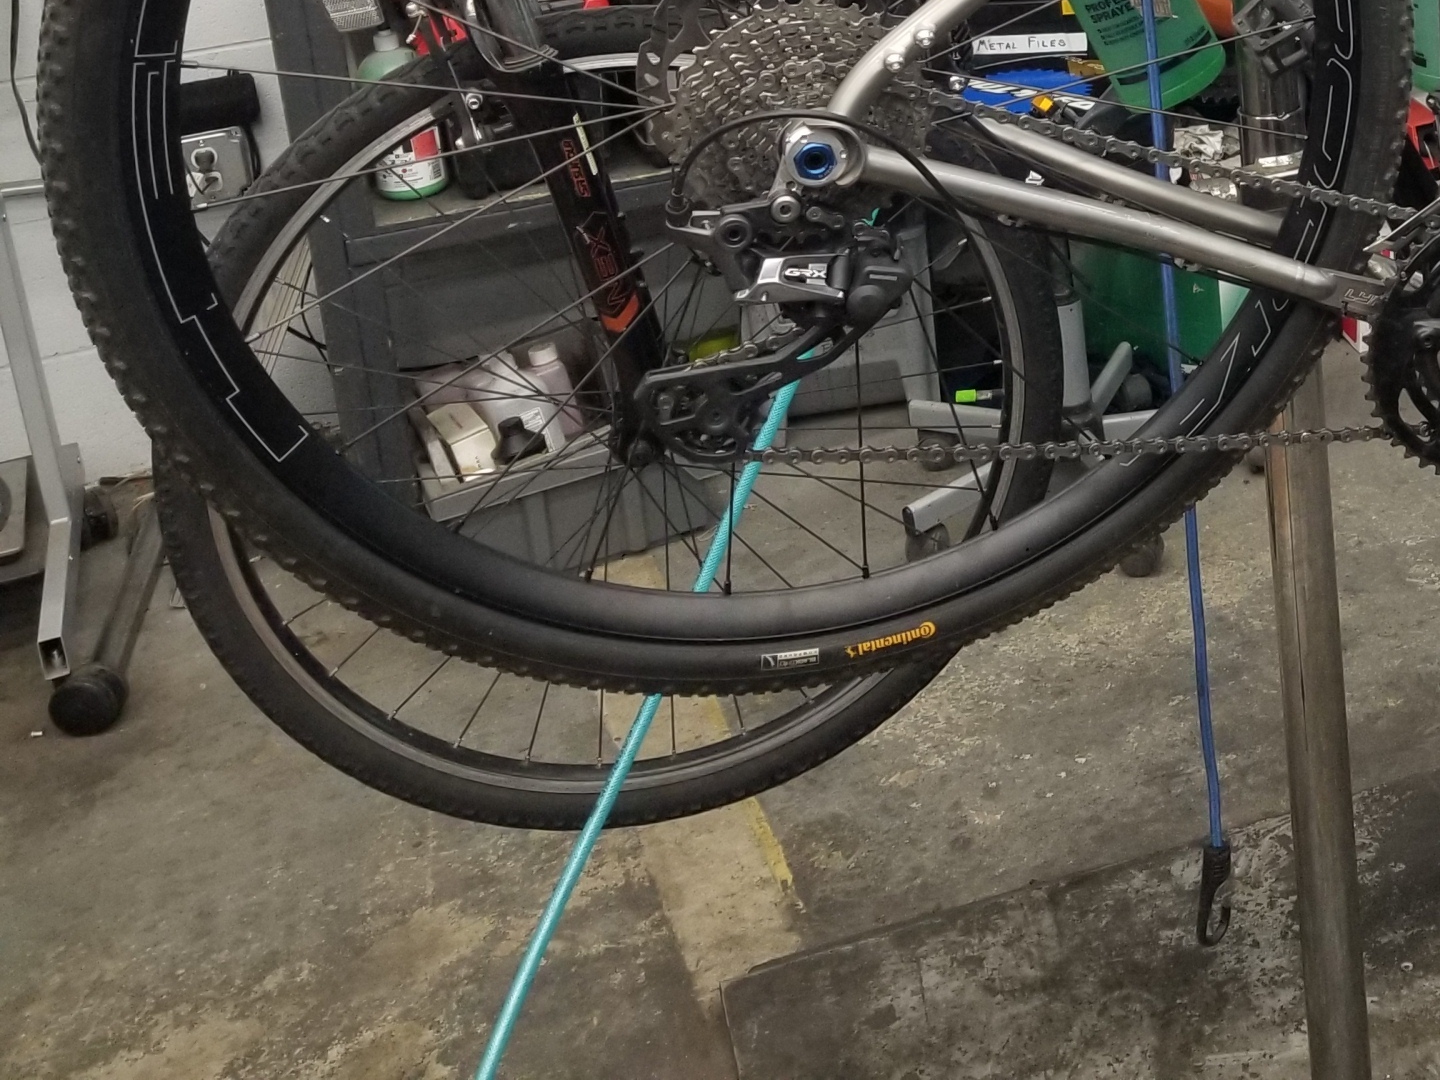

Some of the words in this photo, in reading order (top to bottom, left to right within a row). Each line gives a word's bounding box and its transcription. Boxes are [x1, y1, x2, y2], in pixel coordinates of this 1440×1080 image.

[976, 39, 1018, 52] METAL
[1027, 36, 1067, 49] FILES
[784, 267, 828, 279] GRX
[857, 621, 936, 656] Continental
